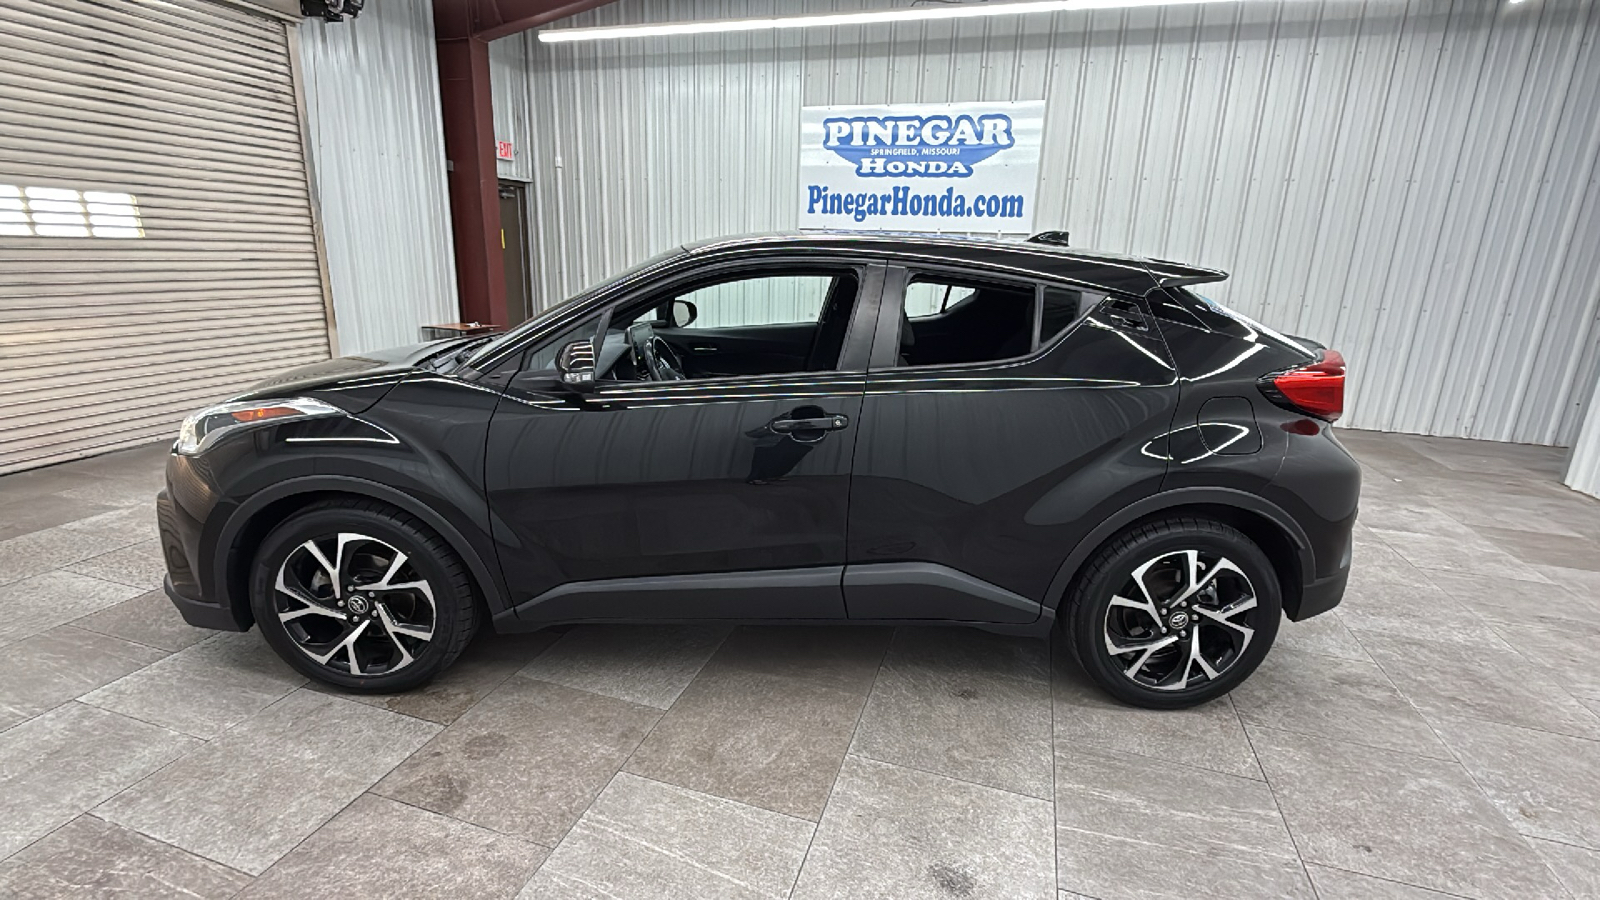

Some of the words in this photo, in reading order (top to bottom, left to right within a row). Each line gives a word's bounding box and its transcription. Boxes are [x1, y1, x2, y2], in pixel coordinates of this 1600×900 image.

[826, 119, 1010, 146] PINEGAR
[499, 141, 512, 158] EXIT
[870, 148, 919, 156] SPRINGFIELD,
[921, 148, 960, 156] MISSOURI
[860, 158, 969, 174] HONDA
[807, 185, 1024, 222] PinegarHonda.com
